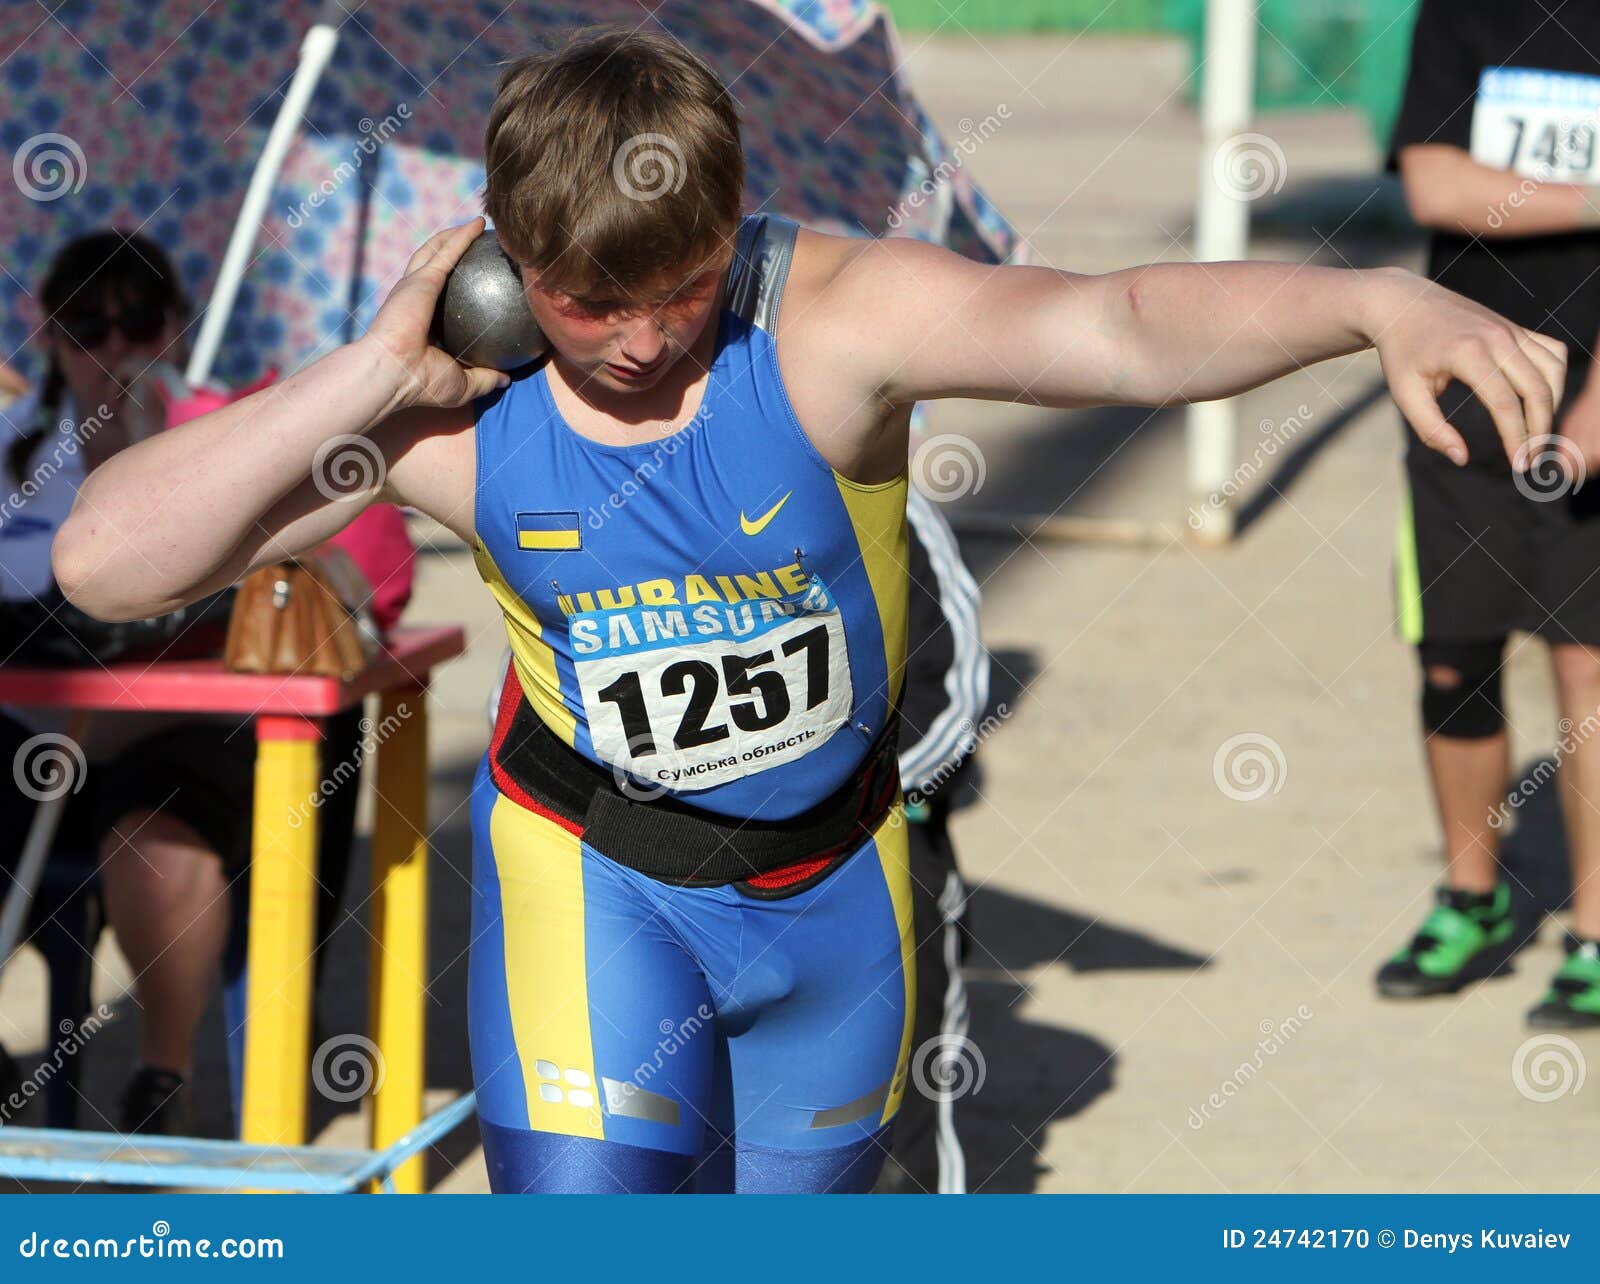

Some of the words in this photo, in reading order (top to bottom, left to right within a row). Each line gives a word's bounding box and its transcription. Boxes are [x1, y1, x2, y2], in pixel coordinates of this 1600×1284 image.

[598, 623, 830, 759] 1257
[656, 754, 738, 781] Сумська
[741, 729, 817, 762] область
